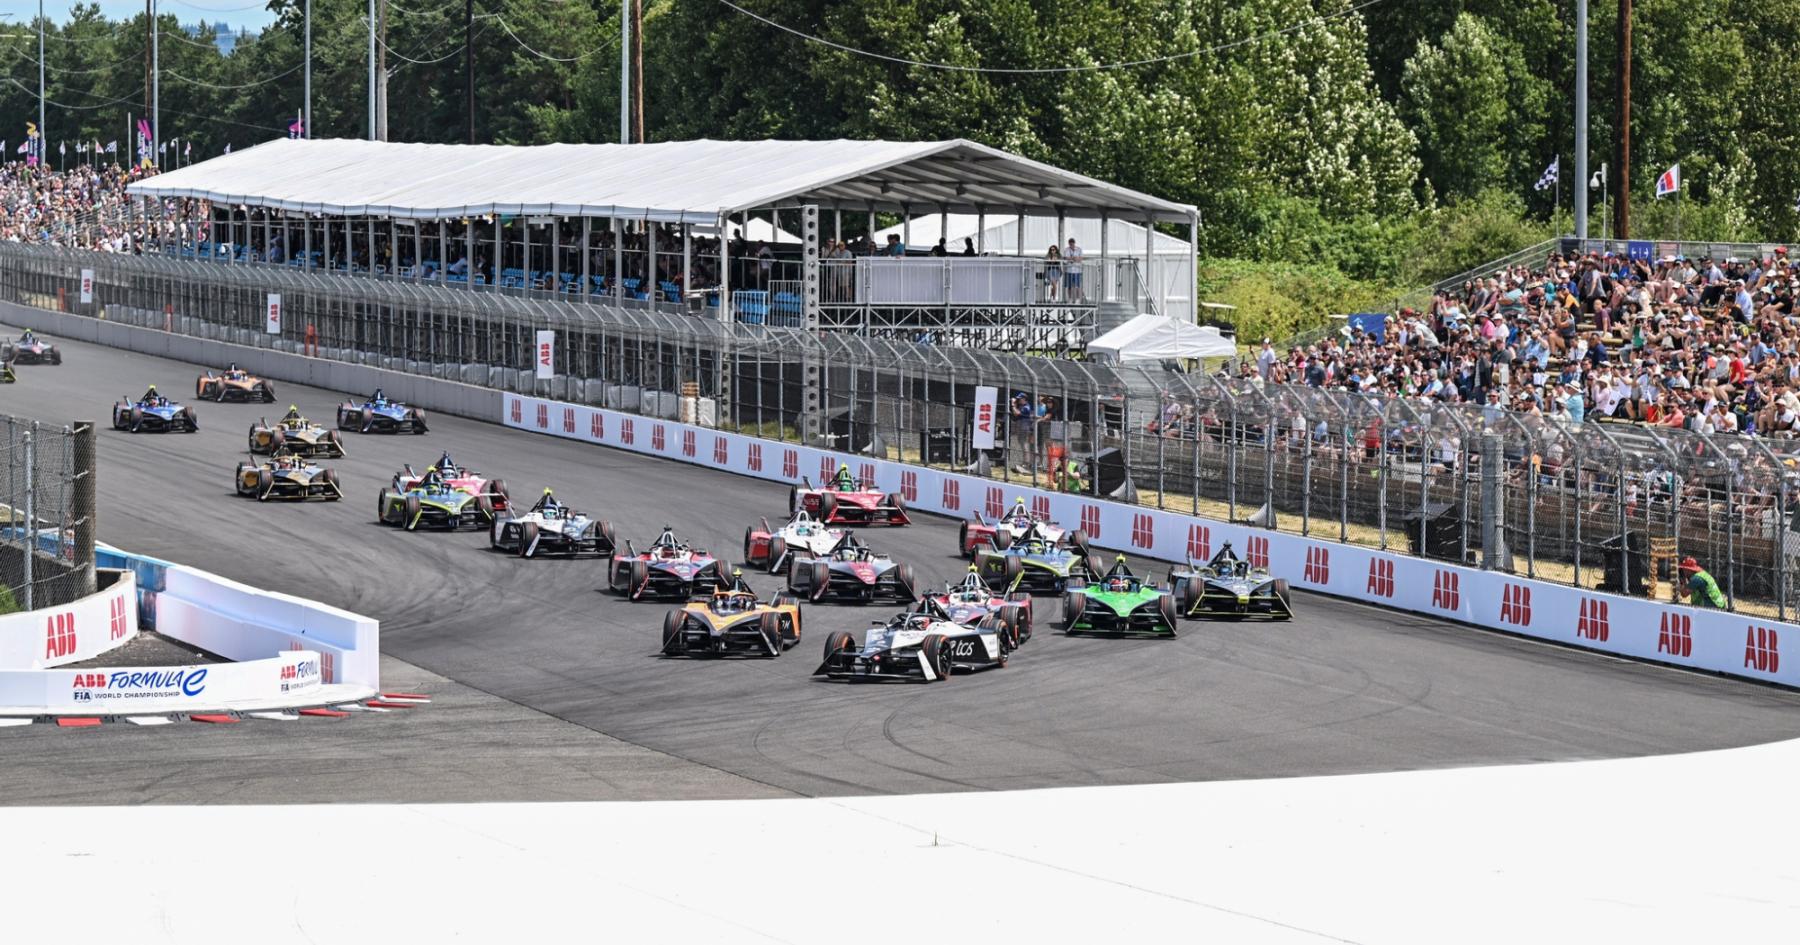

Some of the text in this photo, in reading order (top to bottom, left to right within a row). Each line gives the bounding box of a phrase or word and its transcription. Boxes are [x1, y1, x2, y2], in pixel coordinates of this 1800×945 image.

[541, 343, 550, 366] ABB
[511, 399, 522, 423] ABB
[537, 404, 548, 428] ABB
[563, 408, 575, 433] ABB
[592, 413, 604, 438] ABB
[979, 404, 992, 433] ABB
[620, 419, 634, 445] ABB
[652, 424, 665, 451] ABB
[683, 430, 696, 457] ABB
[714, 436, 728, 464] ABB
[748, 443, 762, 472] ABB
[783, 449, 798, 479] ABB
[900, 470, 917, 502] ABB
[943, 478, 960, 511] ABB
[986, 487, 1004, 519] ABB
[1081, 504, 1100, 539] ABB
[1132, 513, 1153, 549] ABB
[1187, 524, 1210, 561] ABB
[1247, 535, 1269, 568] ABB
[1304, 546, 1329, 585] ABB
[1367, 557, 1394, 598] ABB
[1432, 569, 1459, 611] ABB
[1501, 583, 1532, 626] ABB
[1577, 597, 1609, 642] ABB
[1658, 612, 1692, 657] ABB
[46, 612, 77, 659] ABB
[956, 641, 975, 656] tcs
[1745, 626, 1779, 673] ABB
[73, 674, 106, 688] ABB
[108, 670, 185, 689] FORMULA
[280, 665, 296, 680] ABB
[124, 691, 181, 699] CHAMPIONSHIP
